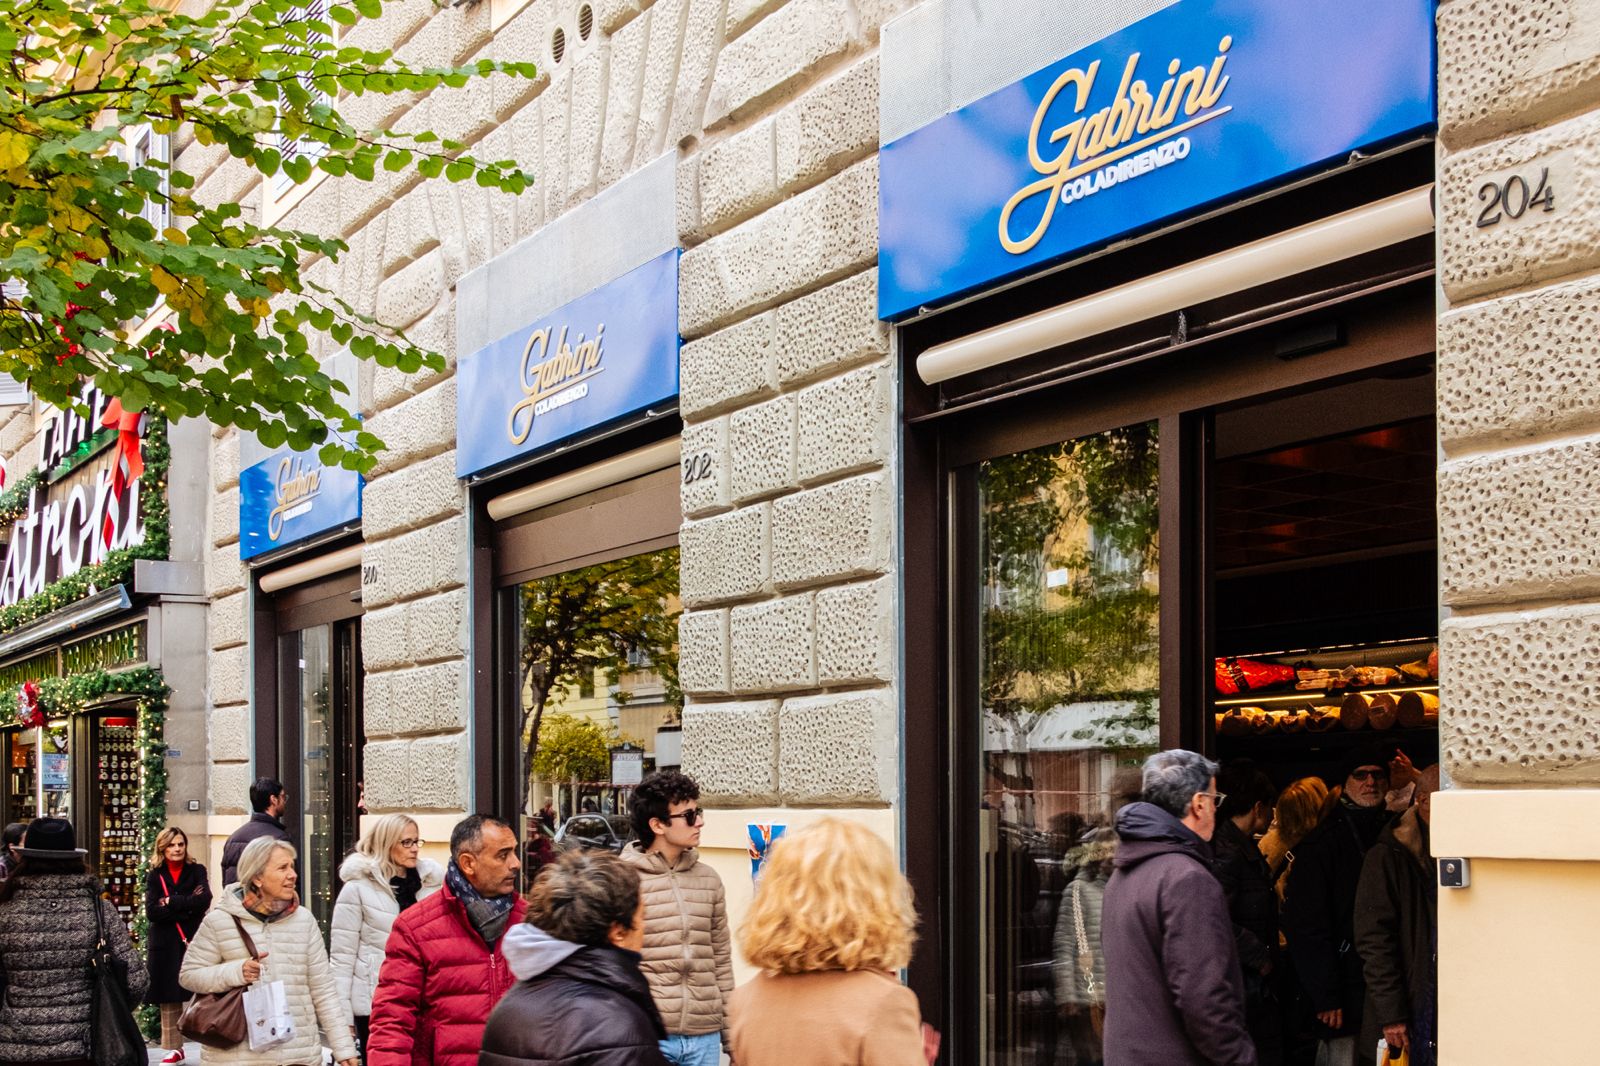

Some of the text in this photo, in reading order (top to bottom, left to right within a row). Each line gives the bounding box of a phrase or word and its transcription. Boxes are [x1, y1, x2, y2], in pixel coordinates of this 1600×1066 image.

[998, 35, 1233, 255] Gabrini
[1060, 136, 1191, 204] COLADIRIENZO
[1476, 166, 1555, 228] 204
[507, 323, 606, 446] Gabrini
[684, 452, 712, 484] 202
